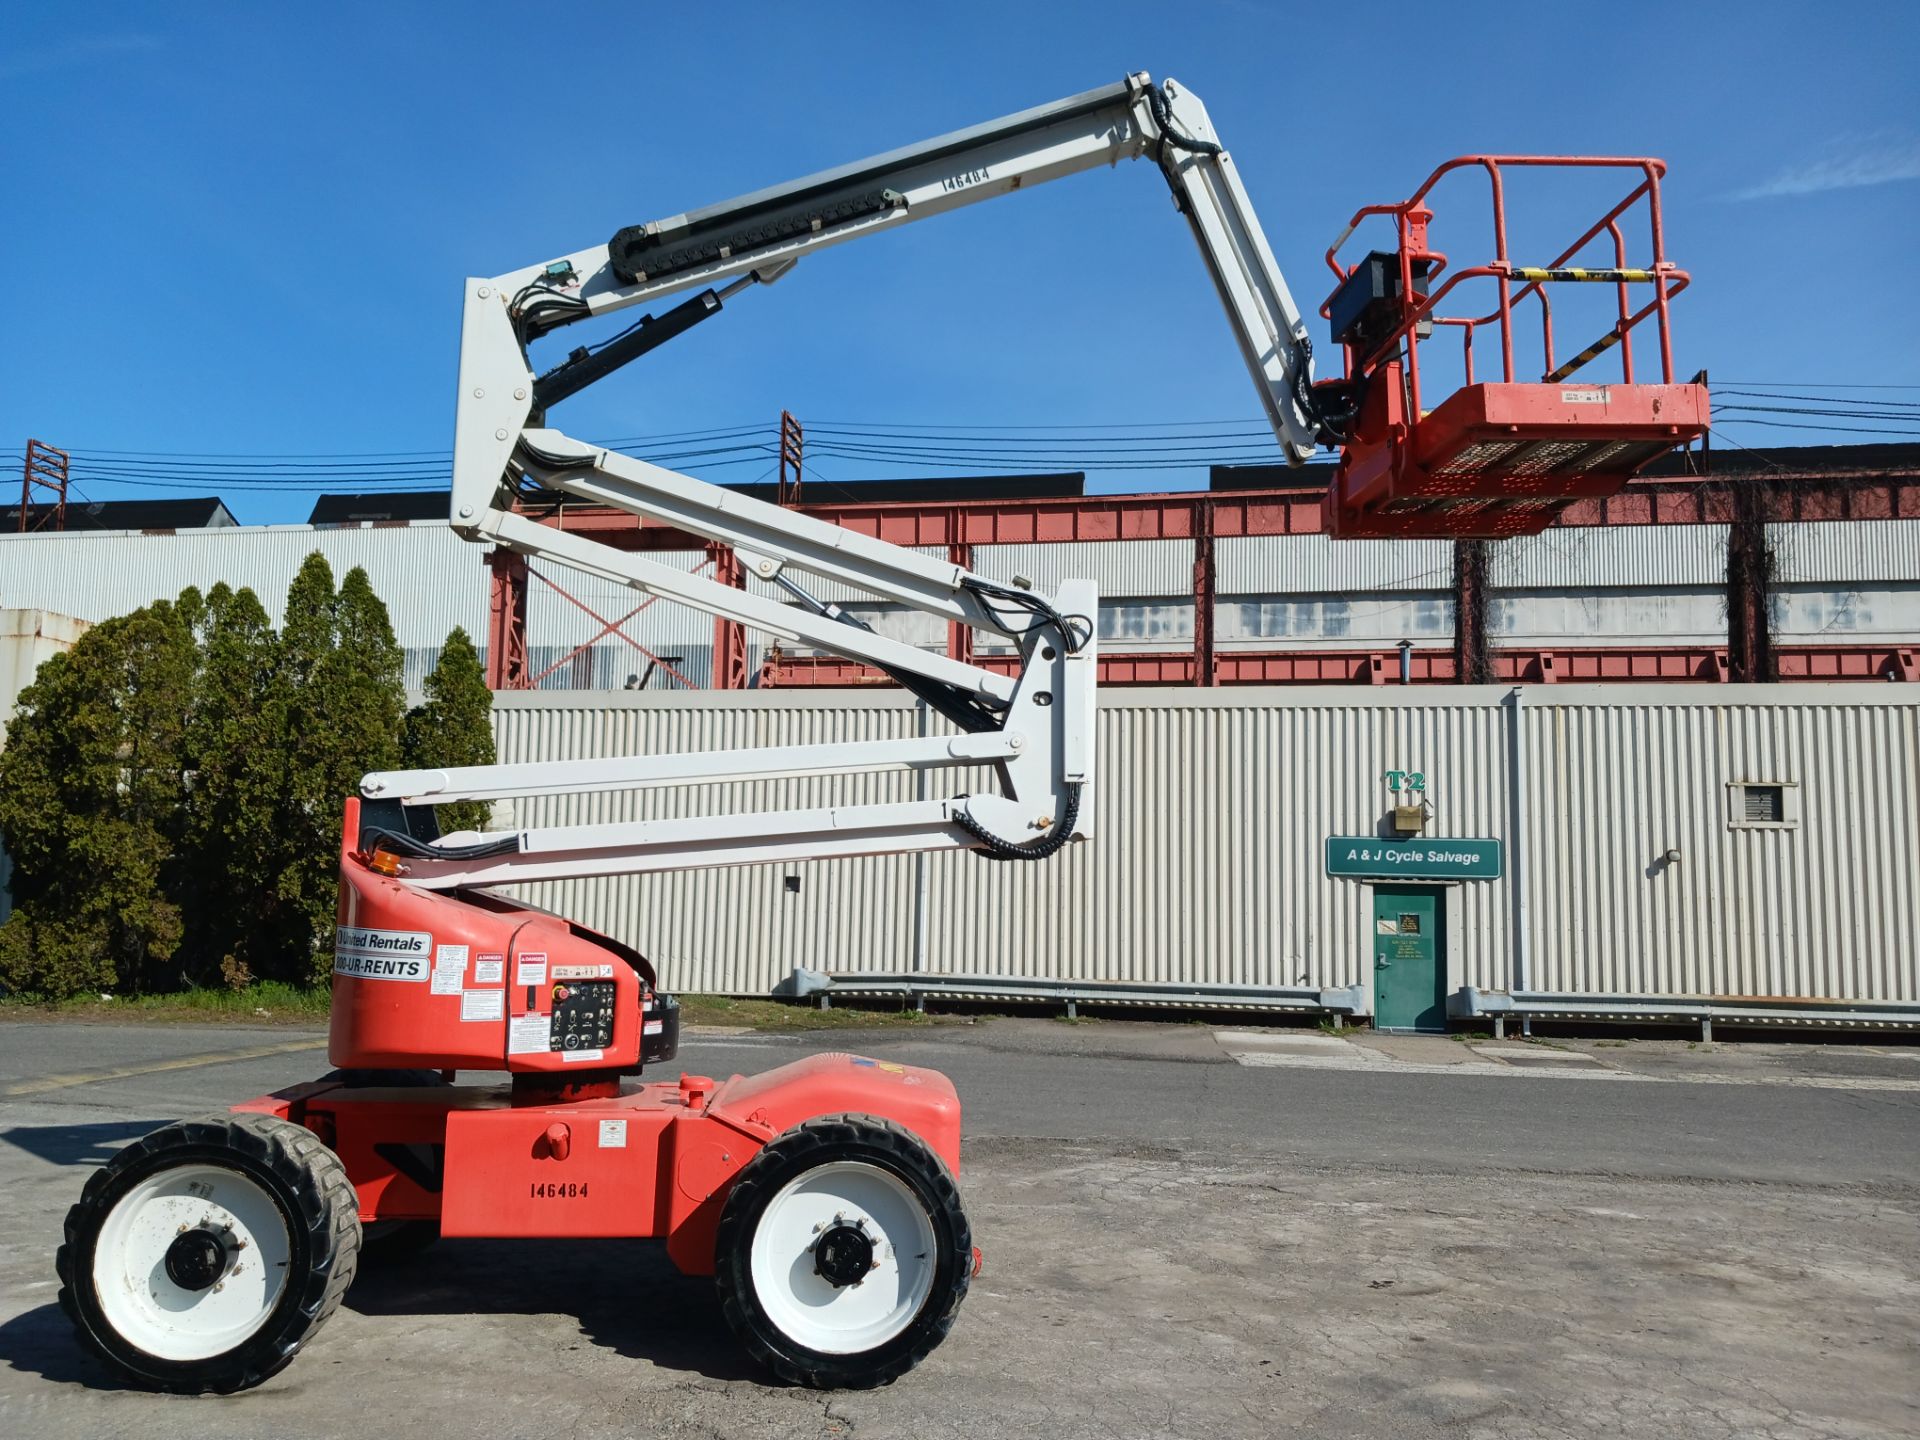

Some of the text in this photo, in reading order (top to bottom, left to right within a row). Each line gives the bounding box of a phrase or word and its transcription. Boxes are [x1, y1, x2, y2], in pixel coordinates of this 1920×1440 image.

[941, 166, 989, 192] 146484
[1347, 850, 1480, 866] A & J Cycle Salvage
[342, 931, 422, 951] United Rentals
[530, 1183, 588, 1198] 146484
